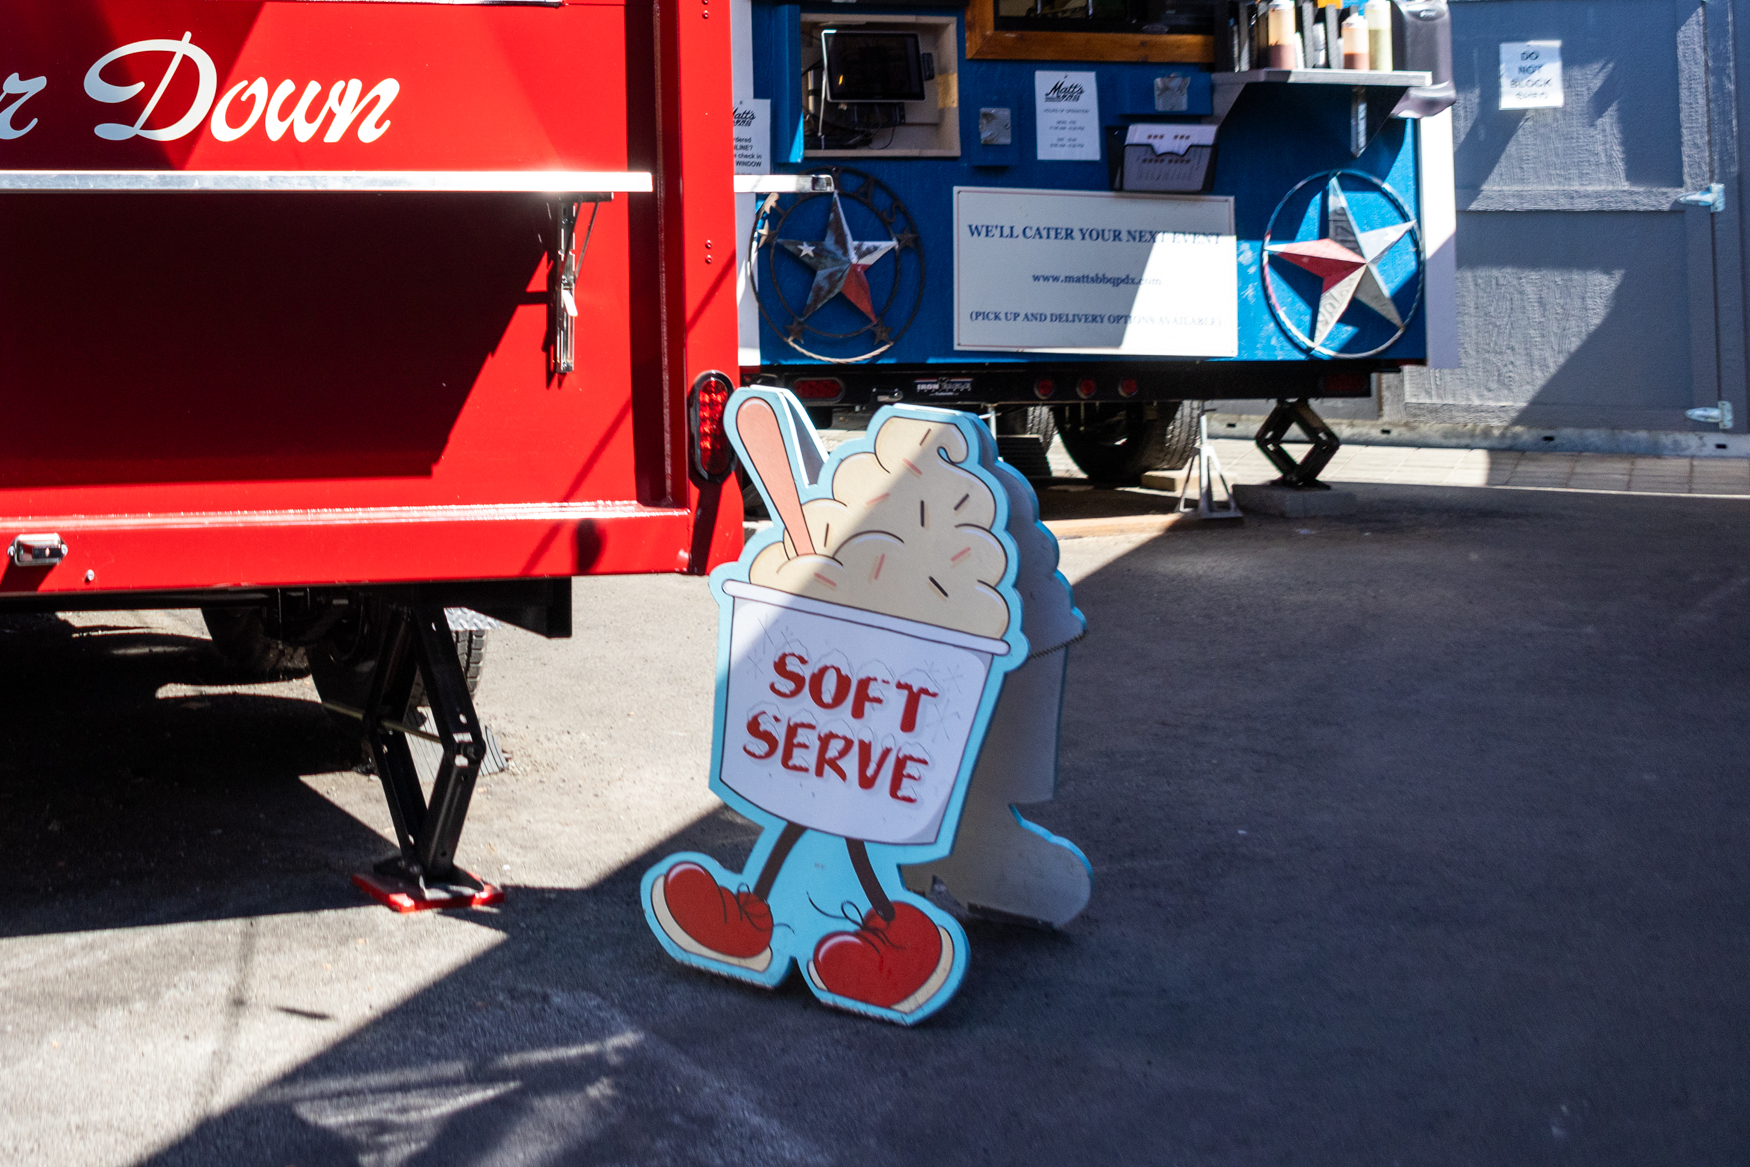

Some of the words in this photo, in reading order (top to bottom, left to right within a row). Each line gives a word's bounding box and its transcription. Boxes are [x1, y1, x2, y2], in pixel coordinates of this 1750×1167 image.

[1521, 51, 1539, 61] DO
[1518, 65, 1543, 74] NOT
[84, 30, 401, 143] Down
[1045, 79, 1085, 98] Matt's
[1510, 78, 1552, 88] BLOCK
[733, 107, 756, 121] att's
[736, 160, 762, 168] WINDOW
[968, 224, 1019, 239] WE'LL
[1022, 225, 1075, 241] CATER
[1079, 228, 1122, 242] YOUR
[1126, 229, 1166, 244] NEXT
[1171, 231, 1222, 245] EVENT
[1032, 272, 1162, 287] www.mattsbbqpdx.com
[969, 310, 1001, 323] (PICK
[1004, 311, 1020, 322] UP
[1023, 312, 1047, 323] AND
[1050, 312, 1105, 324] DELIVERY
[1108, 314, 1155, 325] OPTIONS
[768, 652, 939, 733] SOFT
[742, 711, 929, 804] SERVE
